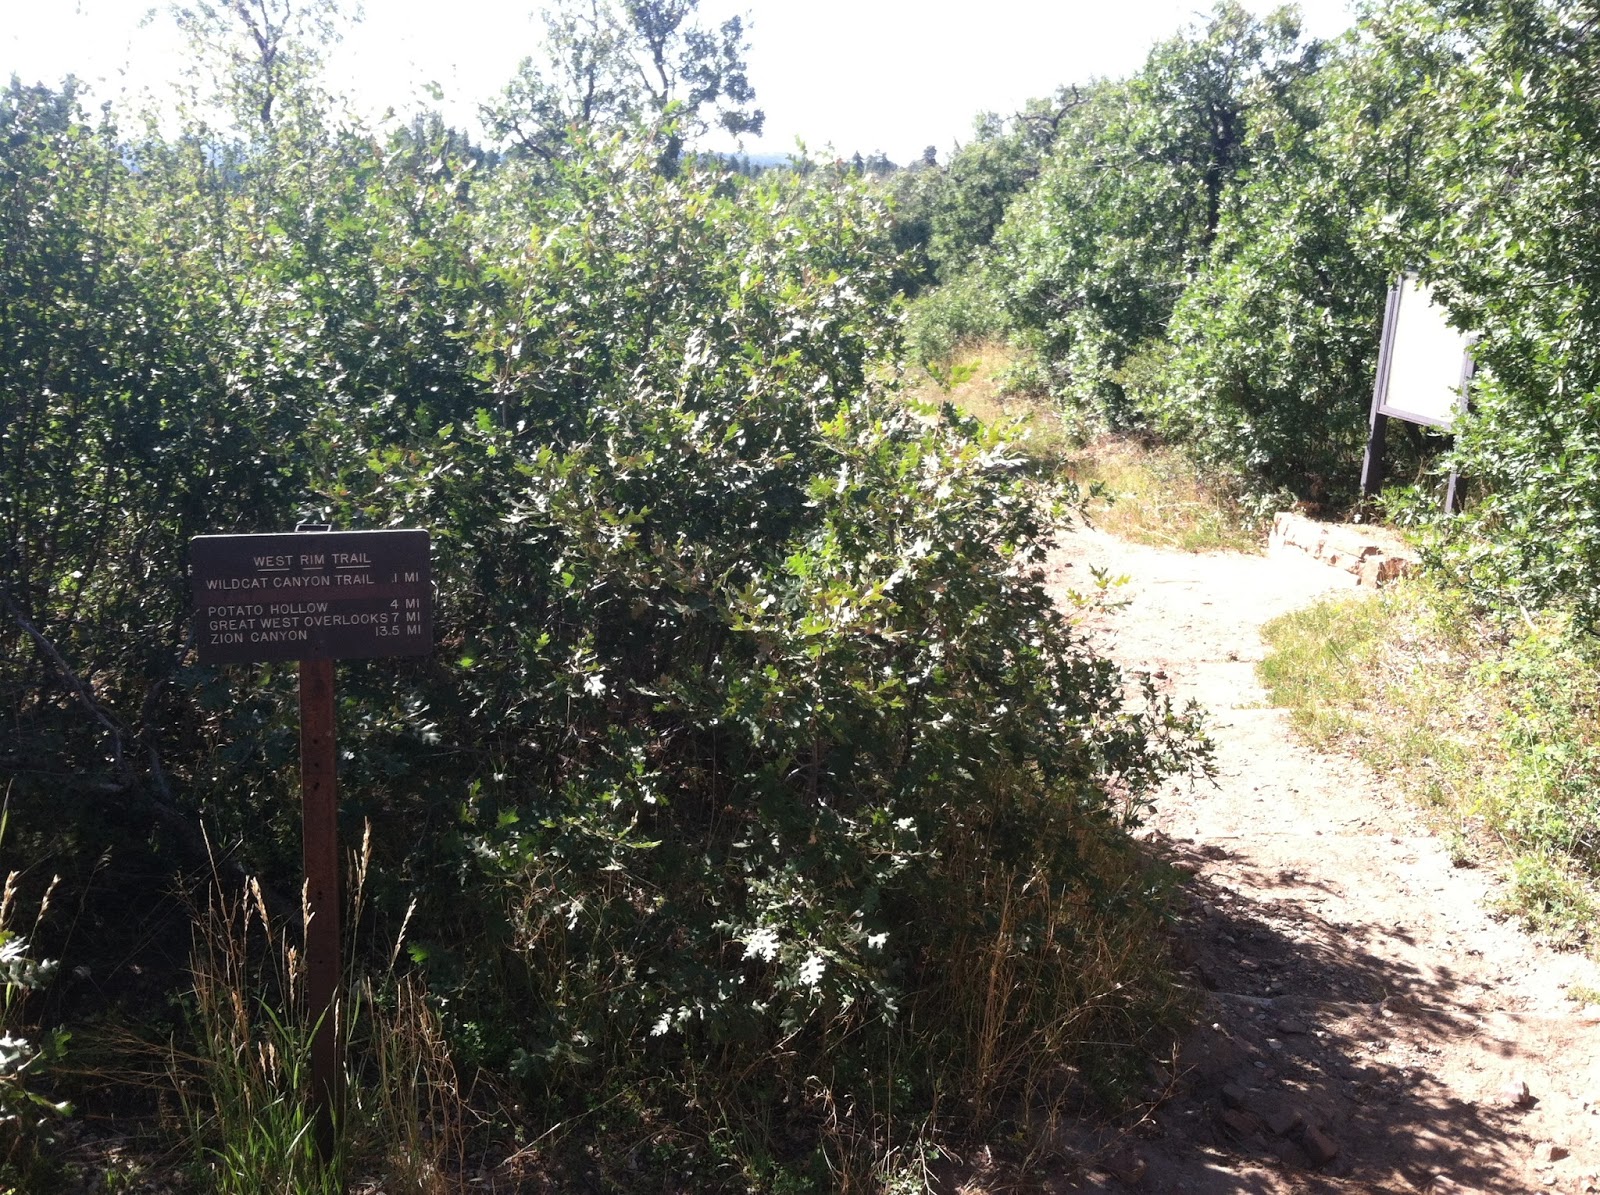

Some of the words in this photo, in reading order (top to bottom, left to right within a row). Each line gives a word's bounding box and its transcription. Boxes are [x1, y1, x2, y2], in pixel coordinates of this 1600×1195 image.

[253, 555, 293, 567] WEST
[300, 554, 325, 565] RIM
[331, 553, 372, 564] TRAIL
[206, 578, 268, 590] WILDCAT
[273, 575, 330, 588] CANYON
[334, 574, 375, 585] TRAIL
[404, 572, 419, 582] MI
[208, 604, 263, 617] POTATO
[270, 602, 328, 615] HOLLOW
[390, 599, 399, 609] 4
[405, 598, 420, 609] MI
[209, 618, 256, 631] GREAT
[260, 616, 299, 629] WEST
[304, 613, 388, 627] OVERLOOKS
[391, 612, 400, 623] 7
[406, 611, 420, 622] MI
[210, 632, 243, 645] ZION
[250, 630, 308, 643] CANYON
[375, 625, 400, 637] 13.5
[406, 624, 421, 635] MI
